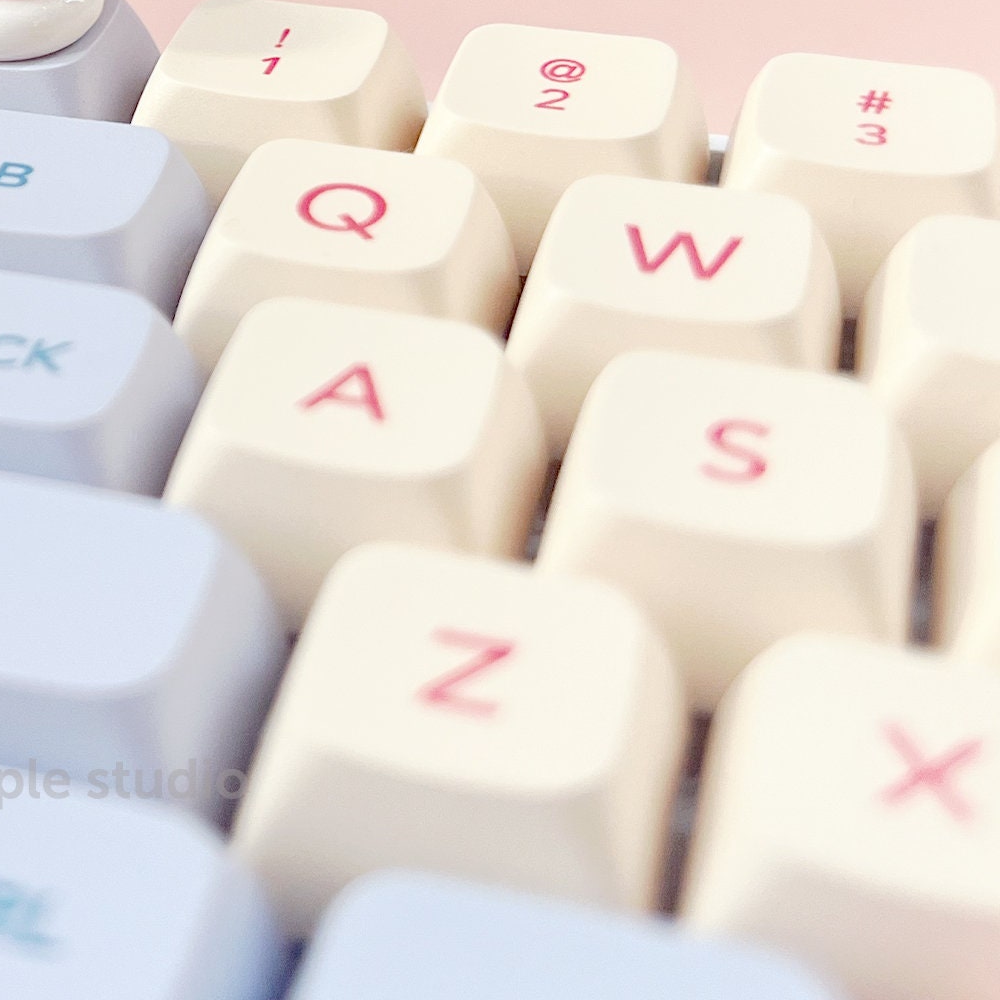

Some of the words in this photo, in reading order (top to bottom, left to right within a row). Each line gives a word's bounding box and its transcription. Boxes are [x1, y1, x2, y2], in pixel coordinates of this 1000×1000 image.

[262, 56, 281, 76] 1
[540, 58, 586, 83] @
[534, 88, 570, 111] 2
[857, 89, 893, 114] #
[855, 123, 888, 146] 3
[296, 182, 387, 240] Q
[625, 223, 743, 281] W
[297, 361, 386, 423] A
[698, 417, 771, 484] S
[416, 626, 514, 718] Z
[878, 719, 983, 822] X
